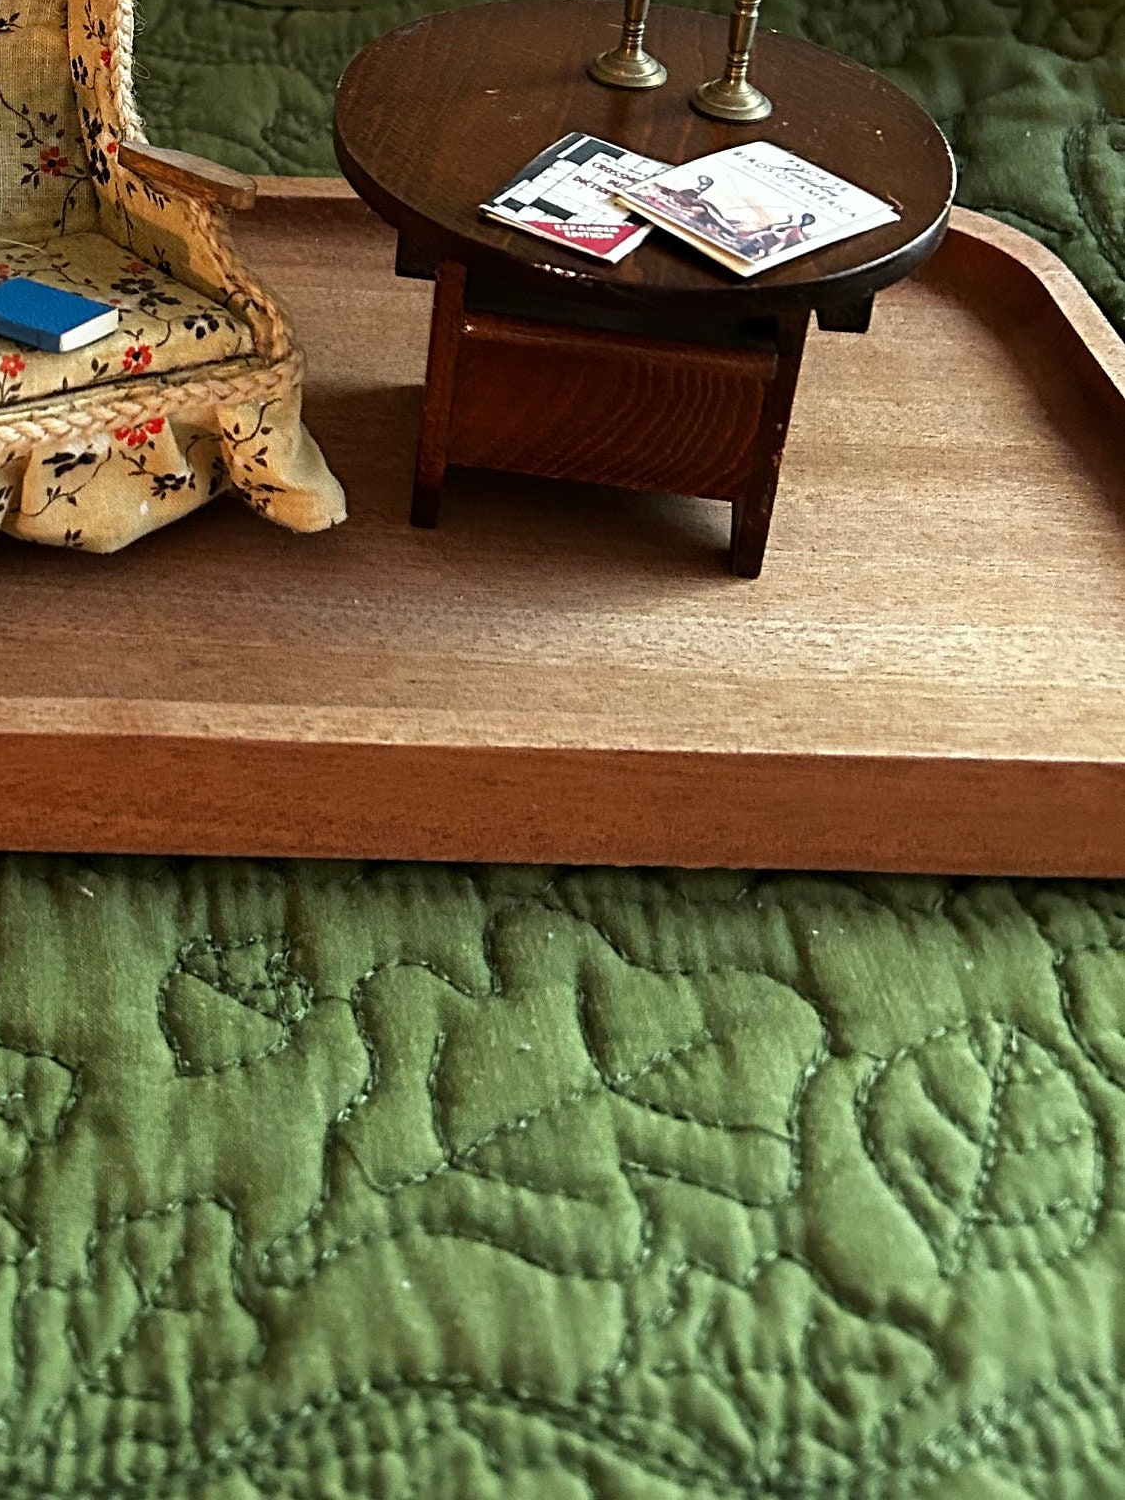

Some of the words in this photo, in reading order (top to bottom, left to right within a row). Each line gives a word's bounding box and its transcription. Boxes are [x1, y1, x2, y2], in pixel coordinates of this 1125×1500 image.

[732, 150, 774, 173] BIRDS
[775, 171, 795, 184] OF
[796, 184, 856, 219] AMERICA
[785, 159, 849, 193] FAVORITE
